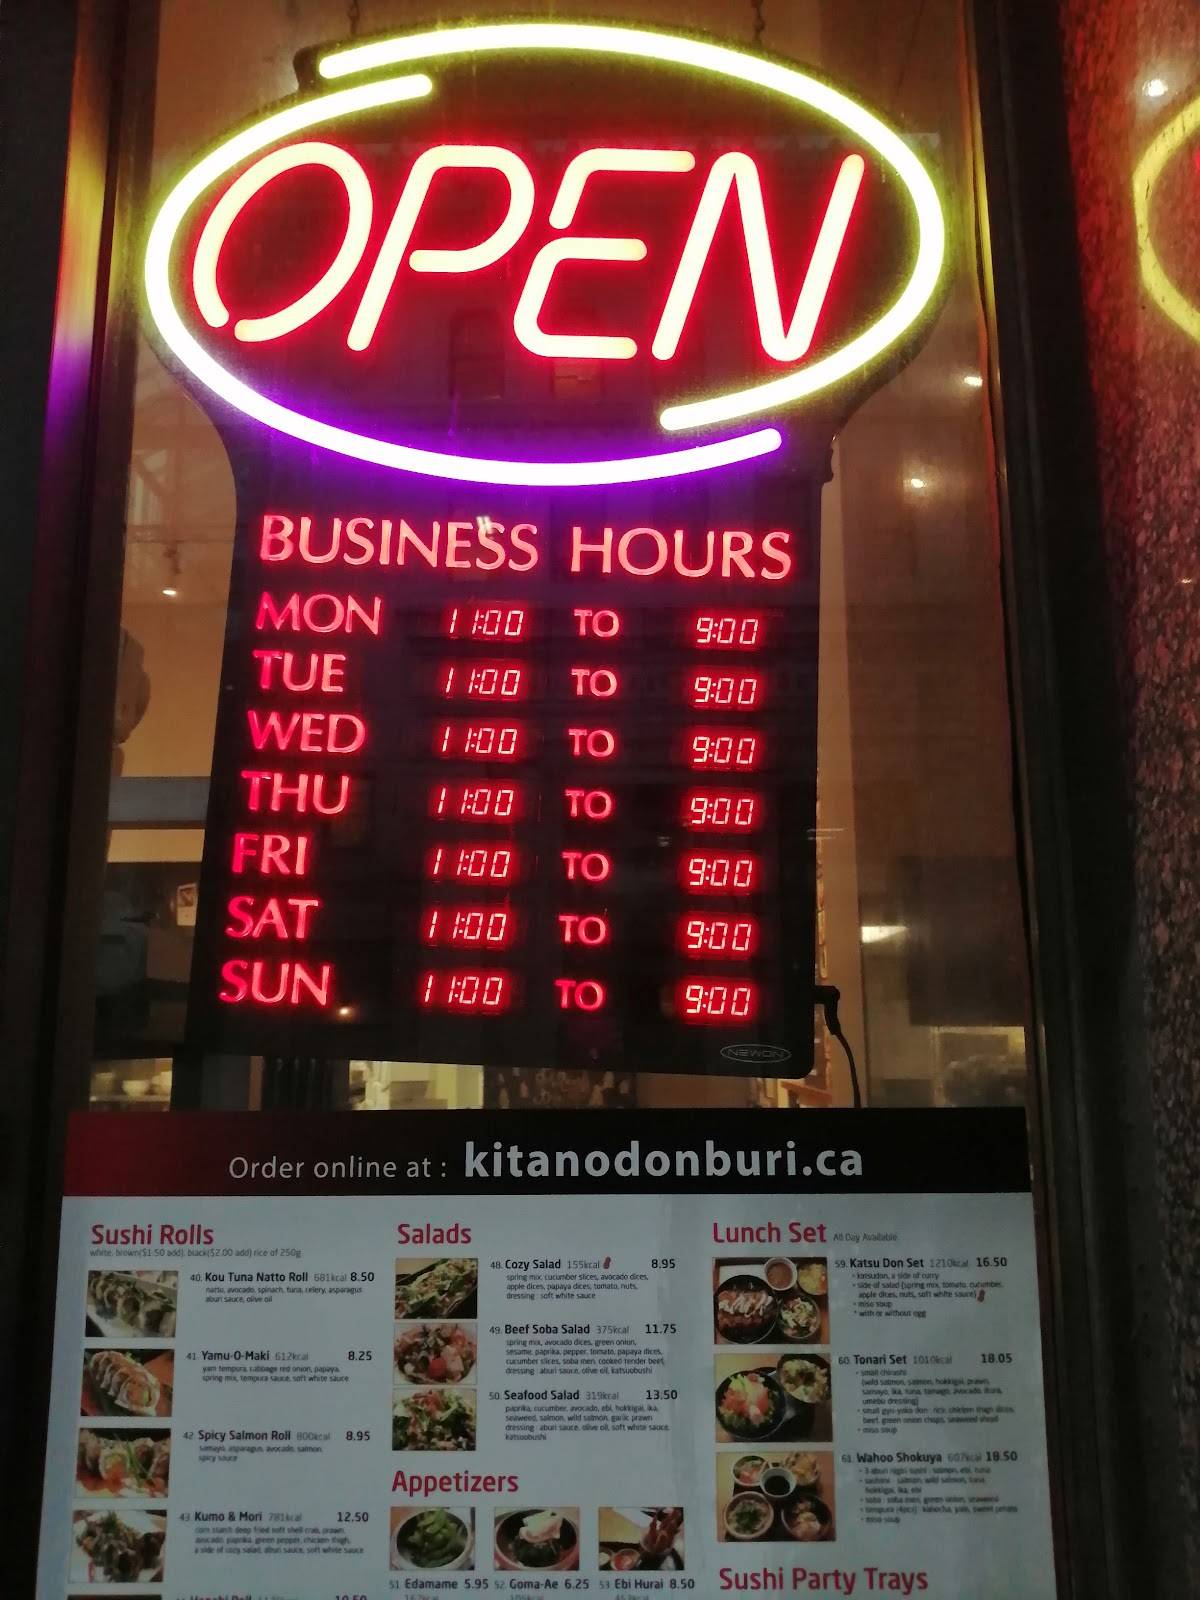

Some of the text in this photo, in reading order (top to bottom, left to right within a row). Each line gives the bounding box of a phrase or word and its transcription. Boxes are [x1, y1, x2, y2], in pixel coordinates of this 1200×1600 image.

[193, 141, 865, 362] OPEN
[259, 514, 793, 580] BUSINESS HOURS
[255, 592, 759, 645] MON 11:00 TO 9:00
[252, 649, 757, 705] TUE 11:00 TO 9:00
[247, 710, 756, 765] WED 11:00 TO 9:00
[241, 769, 755, 827] THU 11:00 TO 9:00
[231, 833, 753, 888] FRI 11:00 TO 9:00
[225, 896, 751, 951] SAT 11:00 TO 9:00
[218, 959, 751, 1016] SUN 11:00 TO 9:00
[727, 1048, 783, 1058] NEWON
[228, 1156, 304, 1179] Order
[313, 1156, 396, 1179] online
[406, 1159, 432, 1179] at
[464, 1140, 863, 1178] kitanodonburi.ca
[91, 1224, 214, 1245] Sushi Rolls
[397, 1223, 472, 1244] Salads
[713, 1222, 827, 1243] Lunch Set
[253, 1248, 268, 1258] rice
[270, 1248, 278, 1258] of
[280, 1248, 301, 1258] 250g
[505, 1259, 530, 1272] Cozy
[533, 1259, 561, 1269] Salad
[567, 1259, 600, 1269] 155kcal
[651, 1258, 676, 1269] 8.95
[850, 1258, 879, 1268] Katsu
[883, 1258, 904, 1268] Don
[907, 1258, 924, 1267] Set
[976, 1256, 1007, 1267] 16.50
[205, 1272, 225, 1282] Kou
[228, 1272, 253, 1282] Tuna
[257, 1272, 286, 1282] Natto
[289, 1272, 308, 1282] Roll
[350, 1272, 375, 1282] 8.50
[506, 1274, 528, 1282] spring
[544, 1274, 577, 1282] cucumber
[600, 1274, 629, 1282] avocado
[506, 1283, 525, 1291] apple
[547, 1283, 572, 1291] papaya
[246, 1295, 262, 1303] olive
[264, 1295, 273, 1303] oil
[506, 1292, 596, 1301] dressing soft white sauce
[504, 1324, 530, 1334] Beef
[532, 1324, 559, 1334] Soba
[561, 1324, 590, 1334] Salad
[596, 1325, 630, 1334] 375kcal
[645, 1324, 677, 1334] 11.75
[201, 1351, 270, 1361] Yamu-O-Maki
[274, 1352, 309, 1361] 612kcal
[348, 1351, 372, 1361] 8.25
[854, 1354, 886, 1365] Tonari
[889, 1354, 907, 1365] Set
[981, 1353, 1012, 1364] 18.05
[506, 1367, 534, 1376] dressing
[539, 1367, 557, 1376] aburi
[582, 1367, 598, 1376] olive
[611, 1367, 652, 1376] katsuobushi
[504, 1390, 548, 1400] Seafood
[550, 1390, 580, 1400] Salad
[646, 1389, 678, 1400] 13.50
[198, 1430, 225, 1442] Spicy
[229, 1430, 268, 1441] Salmon
[271, 1430, 291, 1441] Roll
[345, 1430, 371, 1441] 8.95
[218, 1454, 237, 1462] sauce
[856, 1453, 894, 1463] Wahoo
[896, 1452, 943, 1465] Shokuya
[986, 1451, 1018, 1462] 18.50
[392, 1470, 519, 1497] Appetizers
[194, 1512, 225, 1522] Kumo
[228, 1512, 236, 1522] &
[239, 1512, 263, 1522] Mori
[337, 1511, 369, 1523] 12.50
[404, 1579, 458, 1590] Edamame
[464, 1579, 489, 1590] 5.95
[509, 1579, 559, 1590] Goma-Ae
[564, 1579, 590, 1590] 6.25
[614, 1579, 632, 1590] Ebi
[634, 1579, 664, 1590] Hurai
[669, 1579, 696, 1590] 8.50
[719, 1567, 928, 1595] Sushi Party Trays
